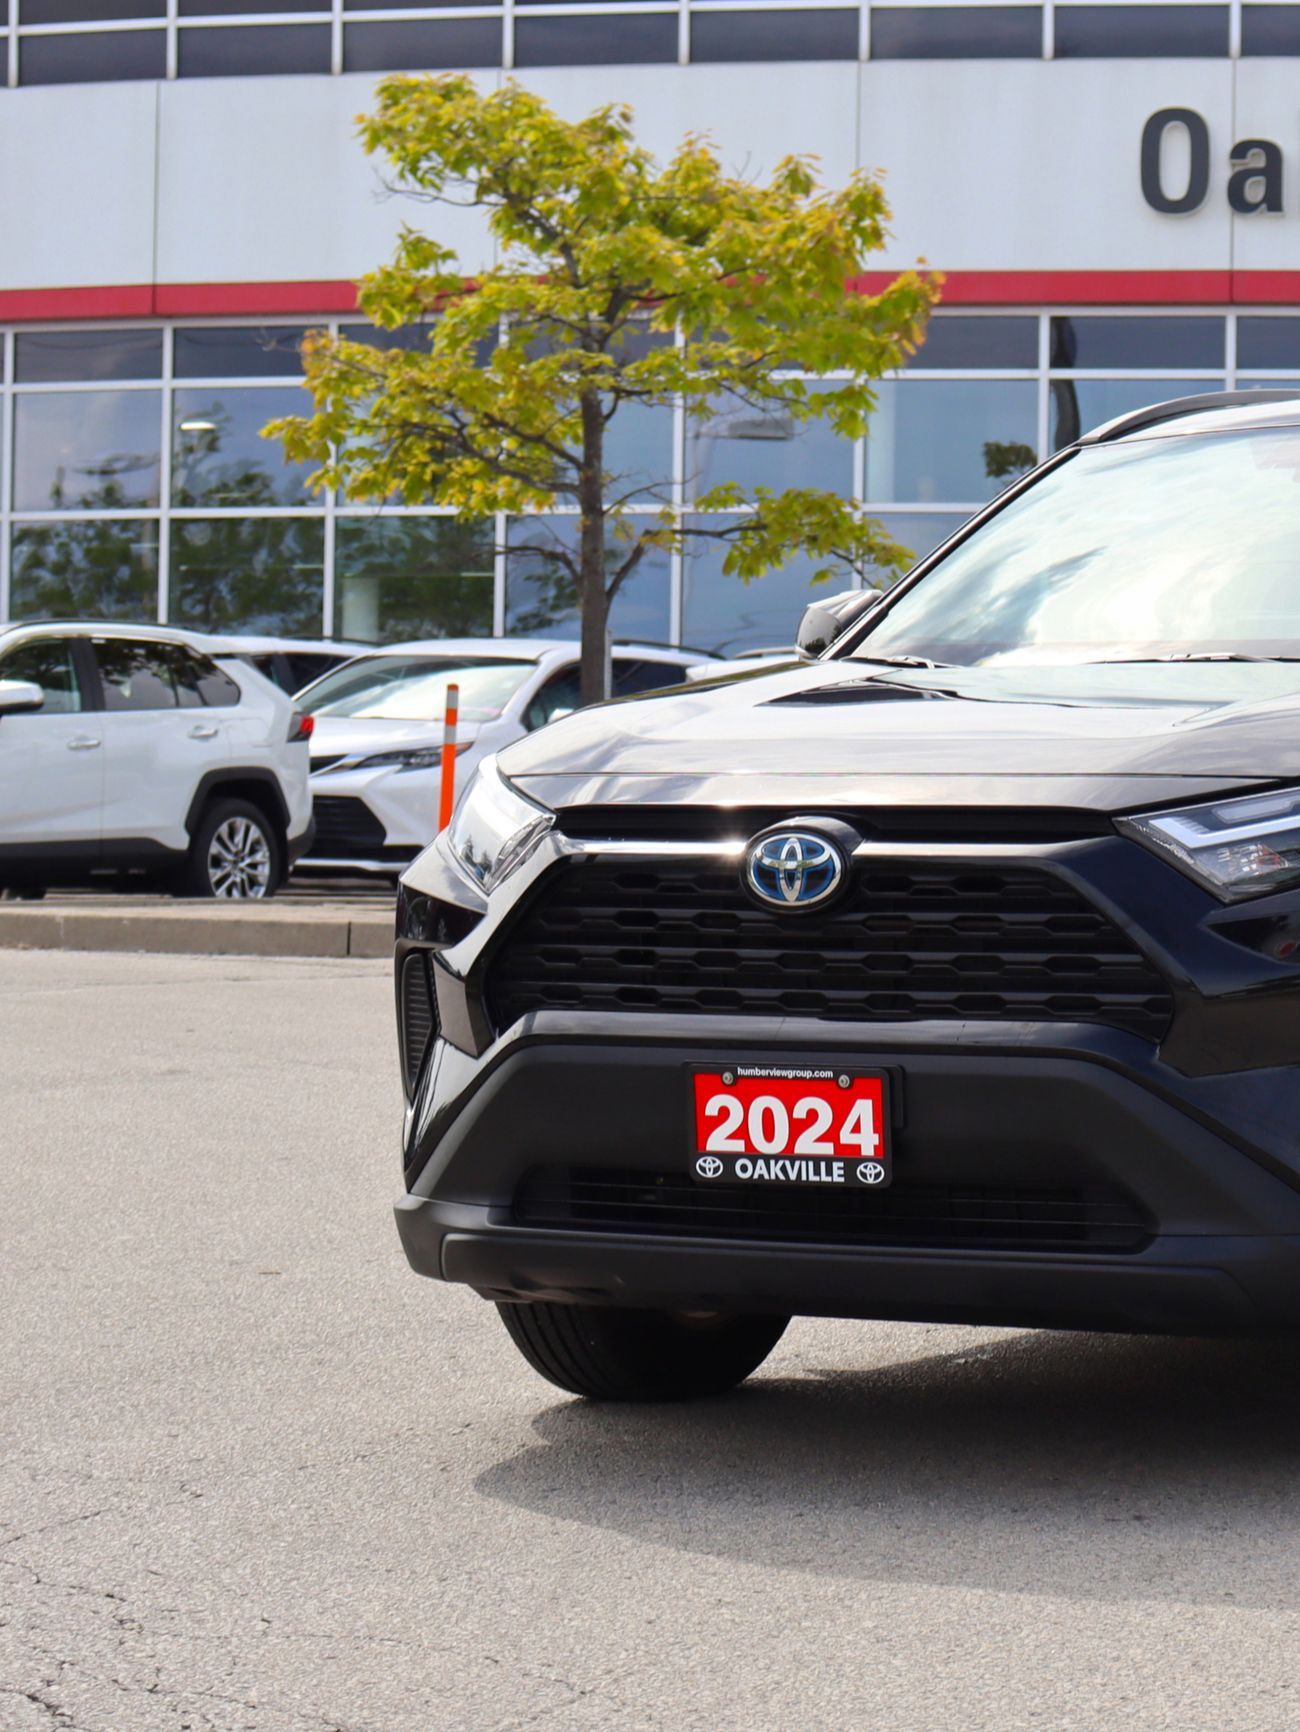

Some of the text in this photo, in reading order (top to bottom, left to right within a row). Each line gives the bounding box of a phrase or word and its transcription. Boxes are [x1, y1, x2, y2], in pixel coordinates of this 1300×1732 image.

[737, 1066, 834, 1079] humberviewgroup.com
[704, 1094, 879, 1156] 2024
[734, 1158, 845, 1182] OAKVILLE
